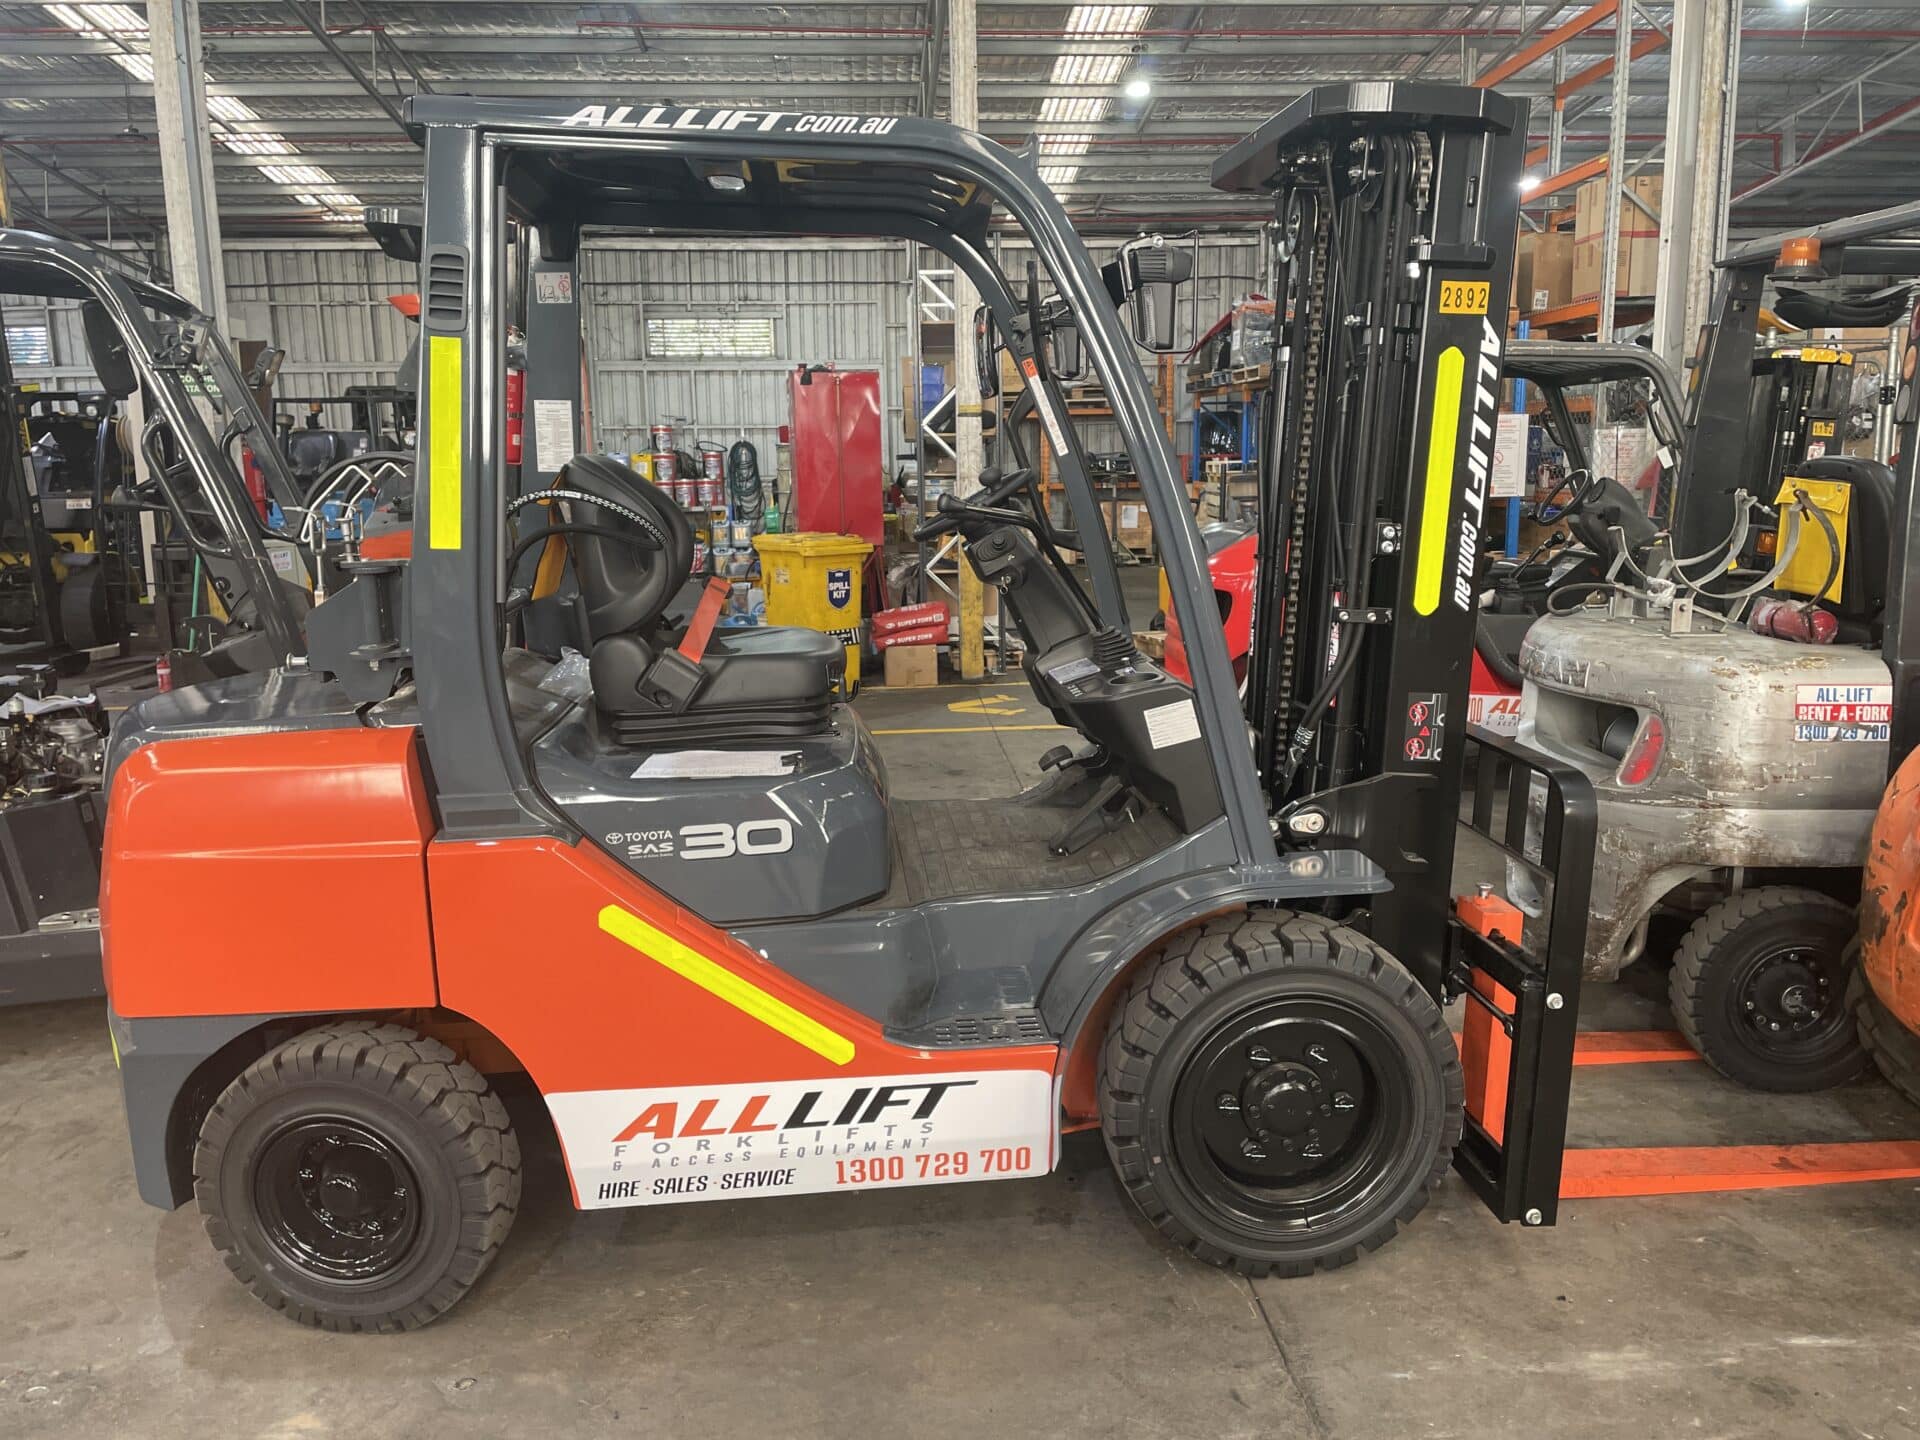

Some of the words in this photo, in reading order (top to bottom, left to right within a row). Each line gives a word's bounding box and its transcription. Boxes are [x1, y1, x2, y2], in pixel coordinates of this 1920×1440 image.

[1443, 287, 1487, 309] 2892
[829, 581, 850, 591] SPILL
[833, 590, 846, 599] KIT
[1816, 687, 1873, 703] ALL-LIFT
[1798, 705, 1889, 721] RENT-A-FORK
[625, 830, 673, 842] TOYOTA
[679, 818, 794, 860] 30
[628, 841, 675, 855] SAS
[612, 1079, 979, 1142] ALLLIFT
[615, 1122, 934, 1157] FORKLIFTS
[613, 1161, 622, 1172] &
[652, 1150, 752, 1170] ACCESS
[779, 1137, 930, 1159] EQUIPMENT
[836, 1156, 904, 1185] 1300
[915, 1151, 969, 1178] 729
[980, 1147, 1031, 1174] 700
[599, 1180, 641, 1200] HIRE
[653, 1175, 709, 1195] SALES
[720, 1168, 797, 1190] SERVICE
